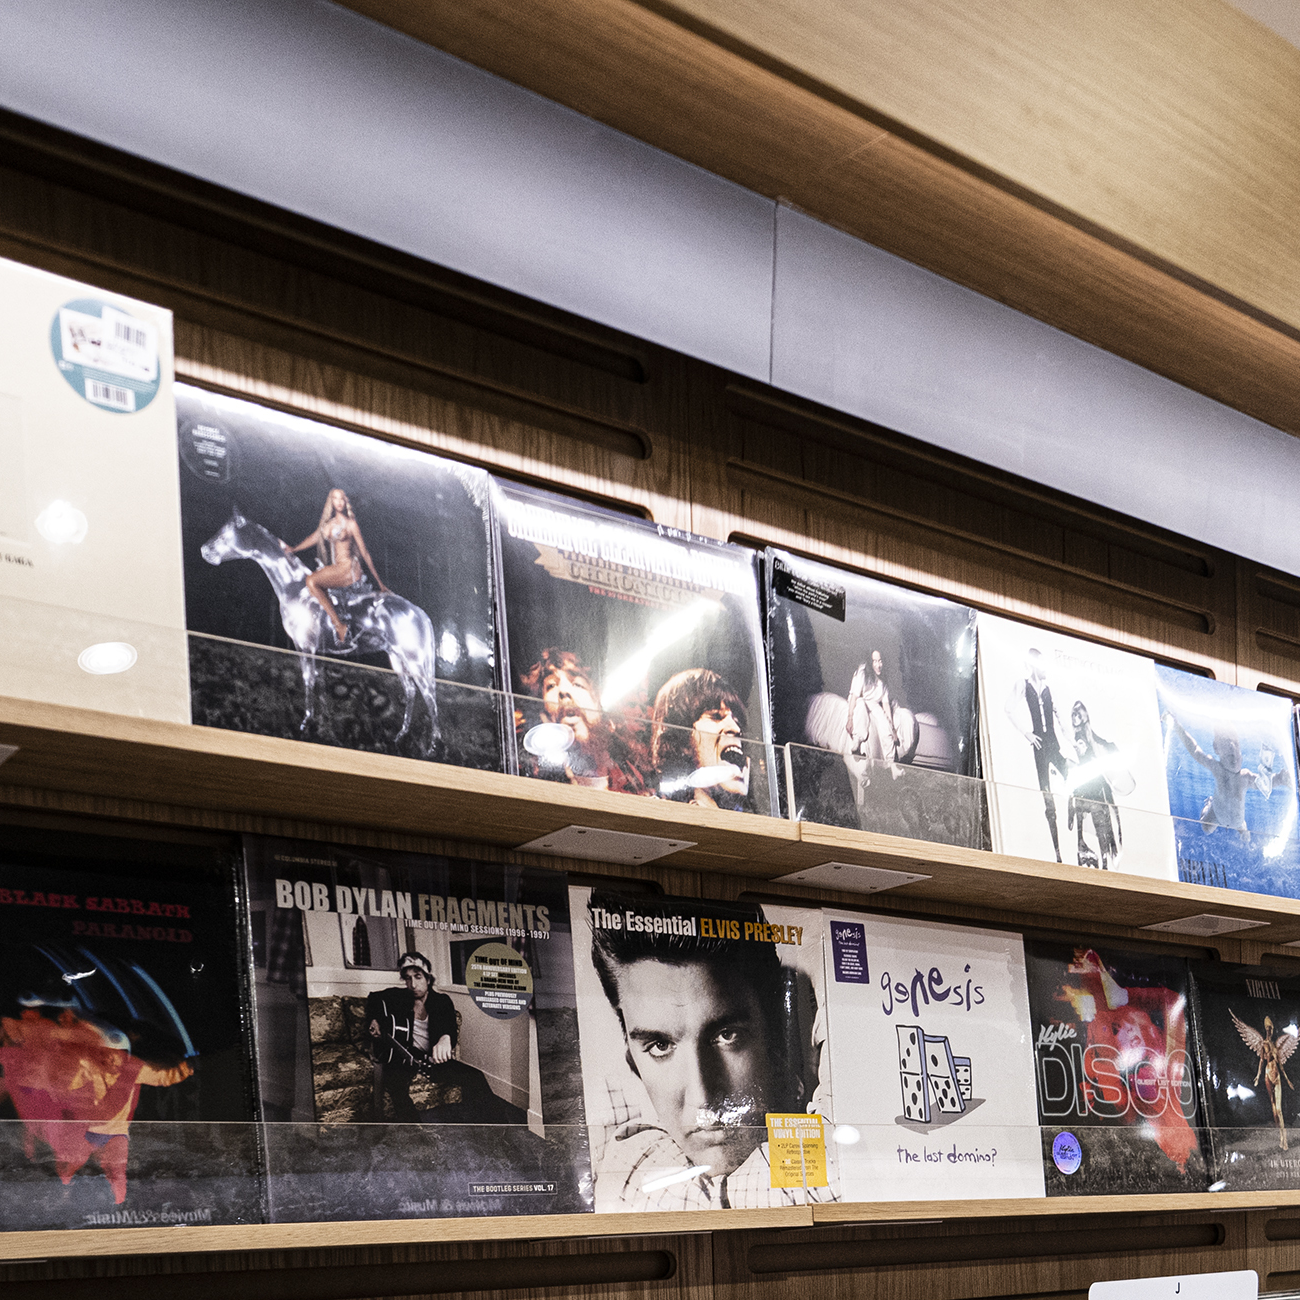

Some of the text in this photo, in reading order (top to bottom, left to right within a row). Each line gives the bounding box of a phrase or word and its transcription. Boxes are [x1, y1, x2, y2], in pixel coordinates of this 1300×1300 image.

[86, 897, 191, 919] SABBATH
[275, 878, 551, 932] BOB DYLAN FRAGMENTS
[71, 920, 193, 943] PARANOID
[404, 918, 423, 929] TIME
[424, 920, 439, 930] OUT
[440, 921, 449, 931] OF
[450, 922, 469, 933] MIND
[470, 923, 505, 936] SESSIONS
[591, 908, 803, 946] The Essential ELVIS PRESLEY
[880, 964, 986, 1017] genesis
[1245, 978, 1282, 1000] NIRVANA
[1037, 1023, 1078, 1051] Kylie
[1035, 1042, 1198, 1119] DISCO
[770, 1117, 783, 1128] THE
[773, 1129, 794, 1139] VINYL
[923, 1143, 999, 1167] last domino?
[486, 1185, 512, 1193] BOOTLEG
[534, 1184, 547, 1192] VOL.
[1175, 1282, 1181, 1294] J
